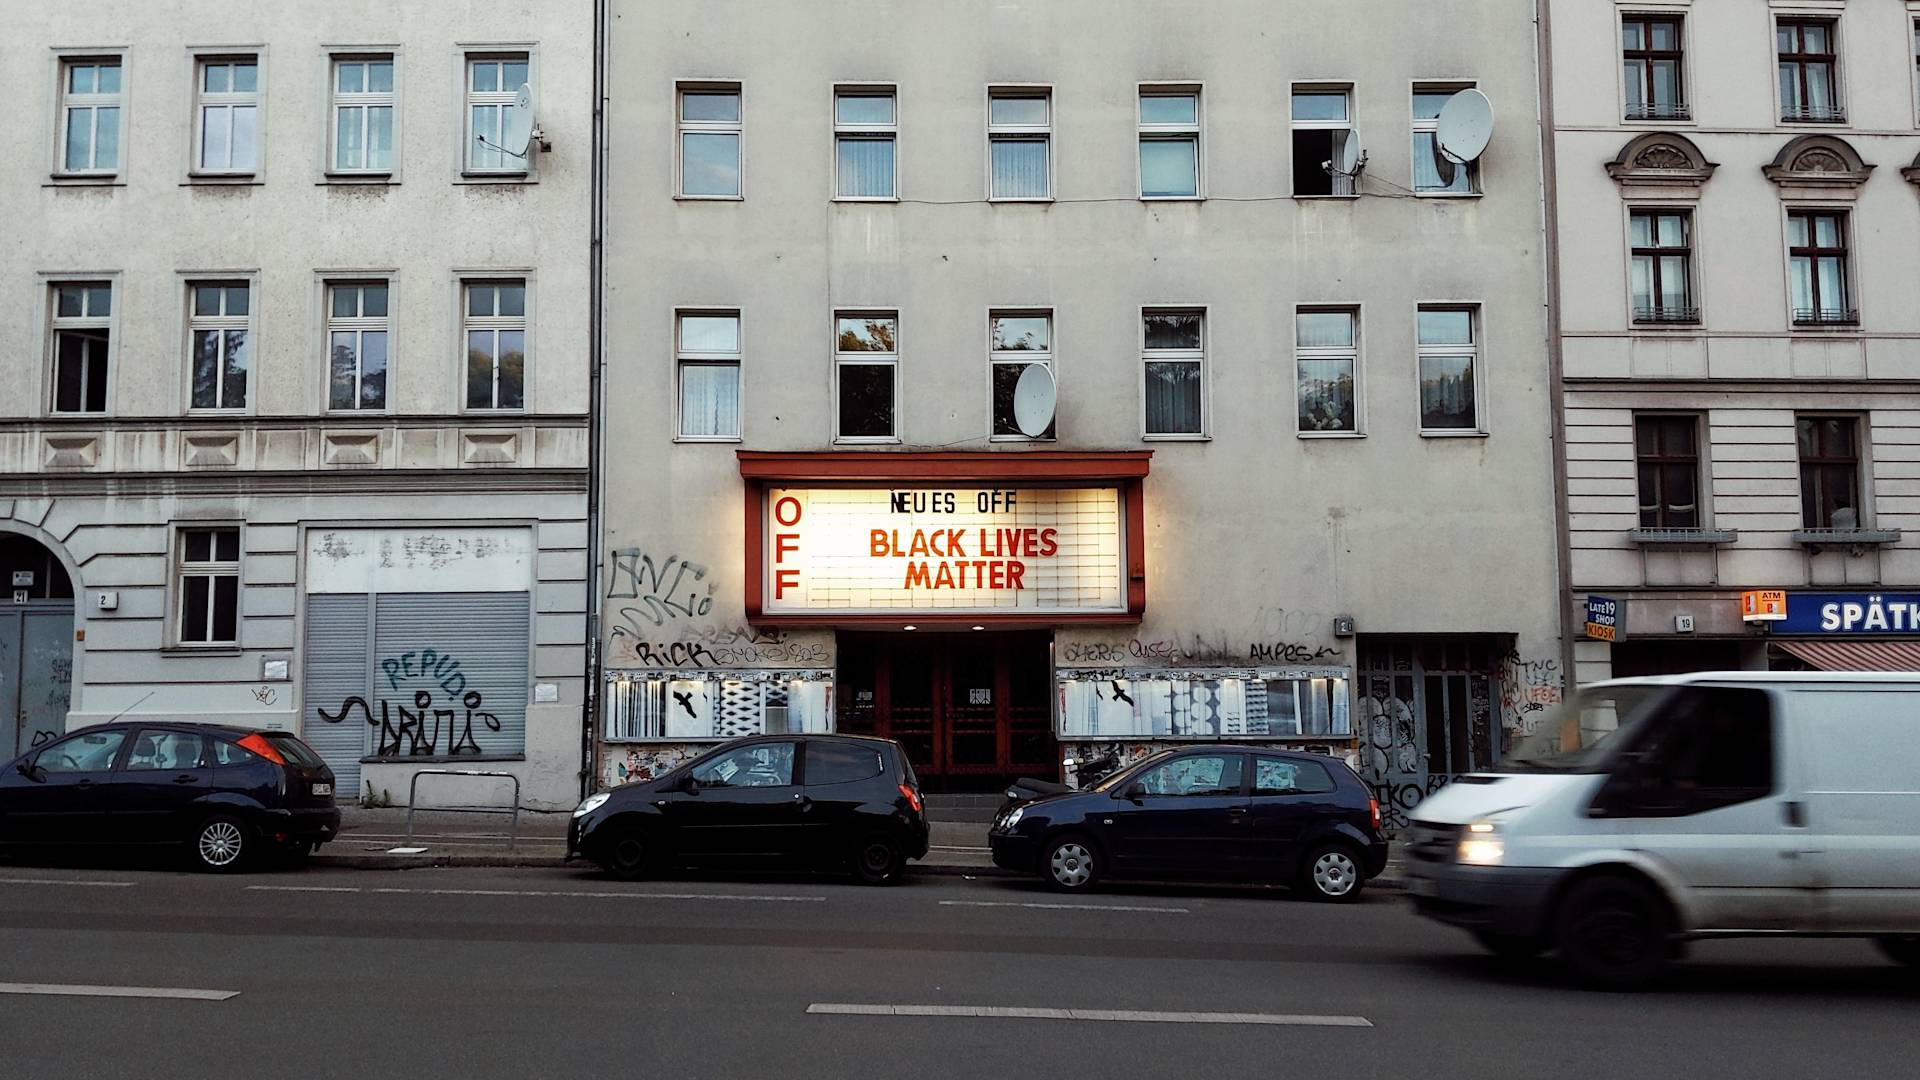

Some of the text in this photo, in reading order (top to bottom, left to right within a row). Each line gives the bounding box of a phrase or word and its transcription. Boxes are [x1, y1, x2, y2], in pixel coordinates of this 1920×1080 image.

[891, 490, 1017, 513] NEUES OFF
[774, 496, 802, 600] OFF
[870, 528, 1058, 557] BLACK LIVES
[904, 561, 1025, 589] MATTER
[16, 591, 25, 602] 21
[1595, 613, 1616, 625] SHOP
[1682, 618, 1691, 629] 19
[1588, 624, 1615, 640] KIOSK
